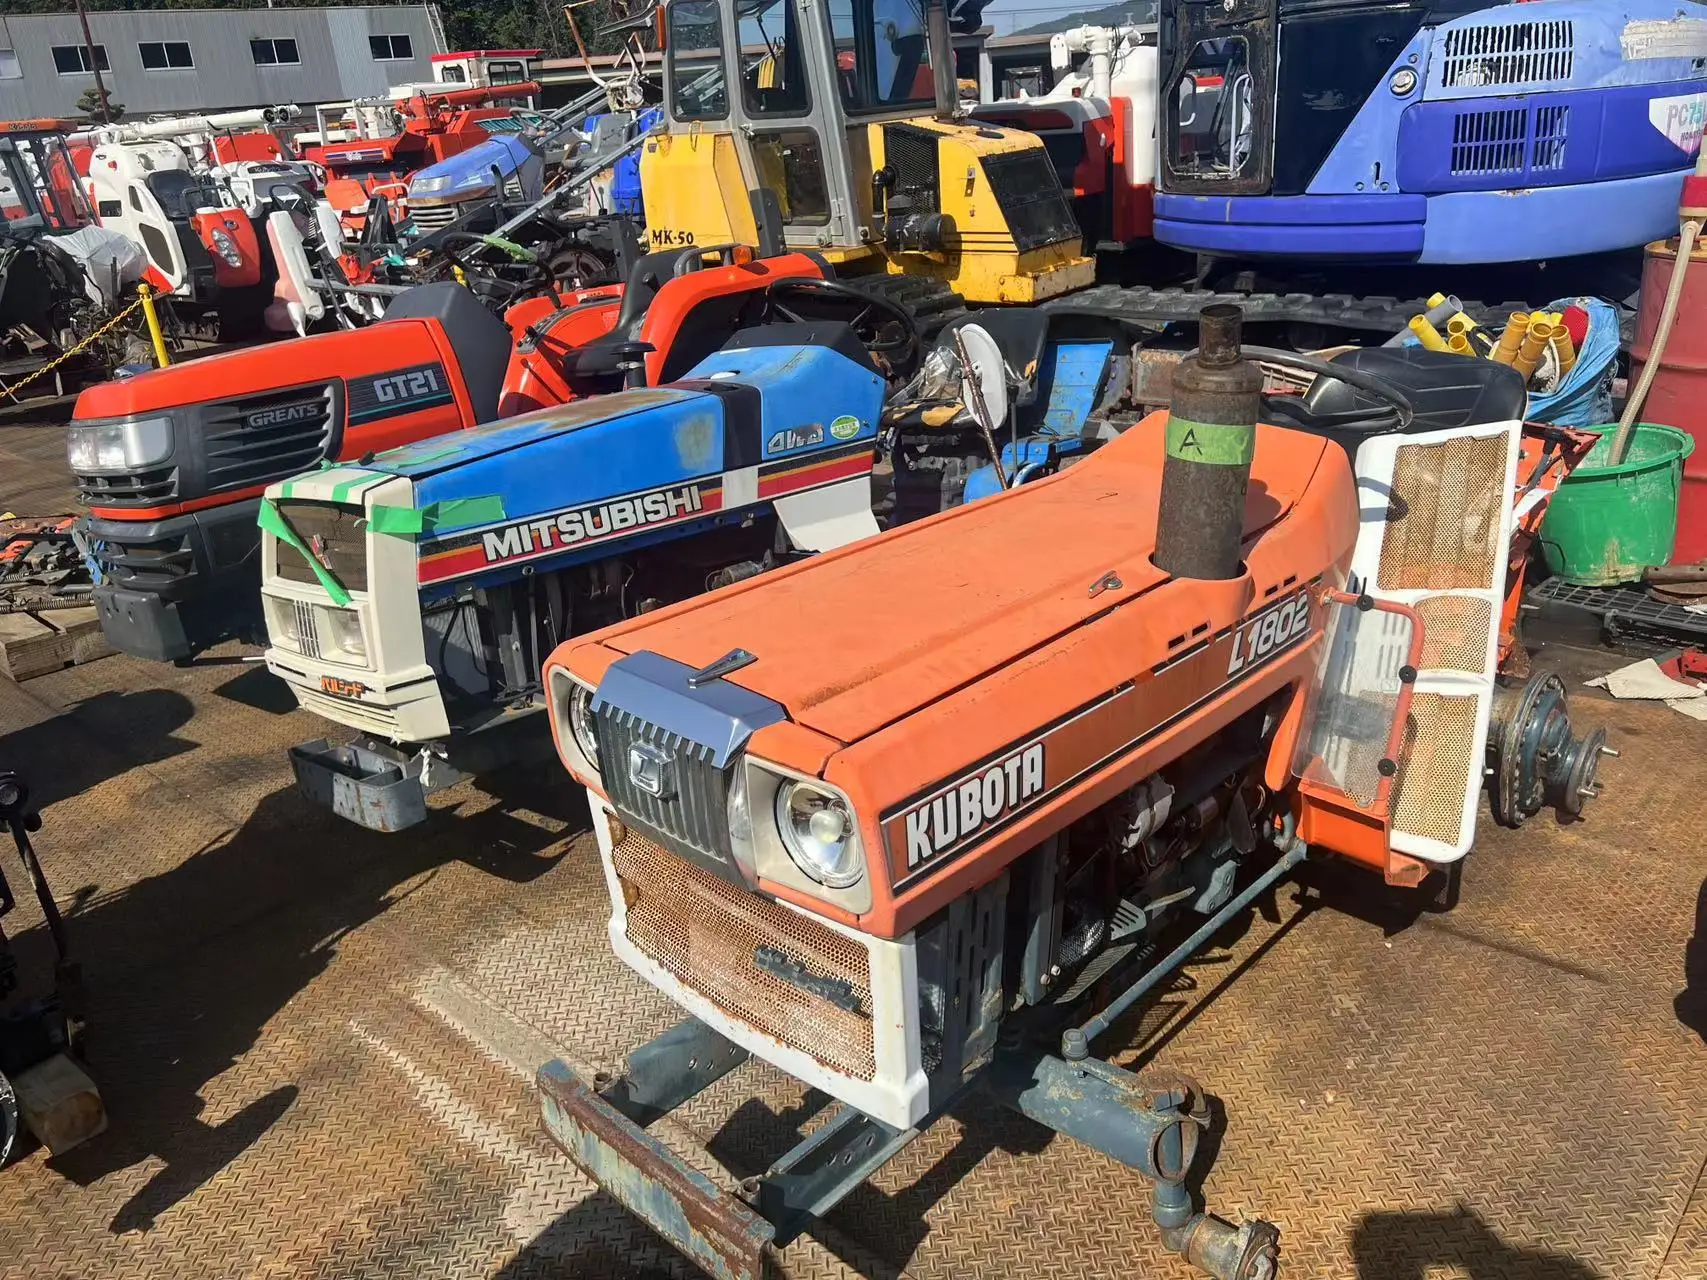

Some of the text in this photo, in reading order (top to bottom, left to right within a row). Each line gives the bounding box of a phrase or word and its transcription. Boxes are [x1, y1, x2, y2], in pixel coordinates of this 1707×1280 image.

[373, 369, 439, 402] GT21
[249, 403, 318, 428] GREATS
[1179, 427, 1203, 456] A
[482, 484, 702, 562] MITSUBISHI
[1227, 593, 1309, 676] L1802
[905, 742, 1044, 869] KUBOTA
